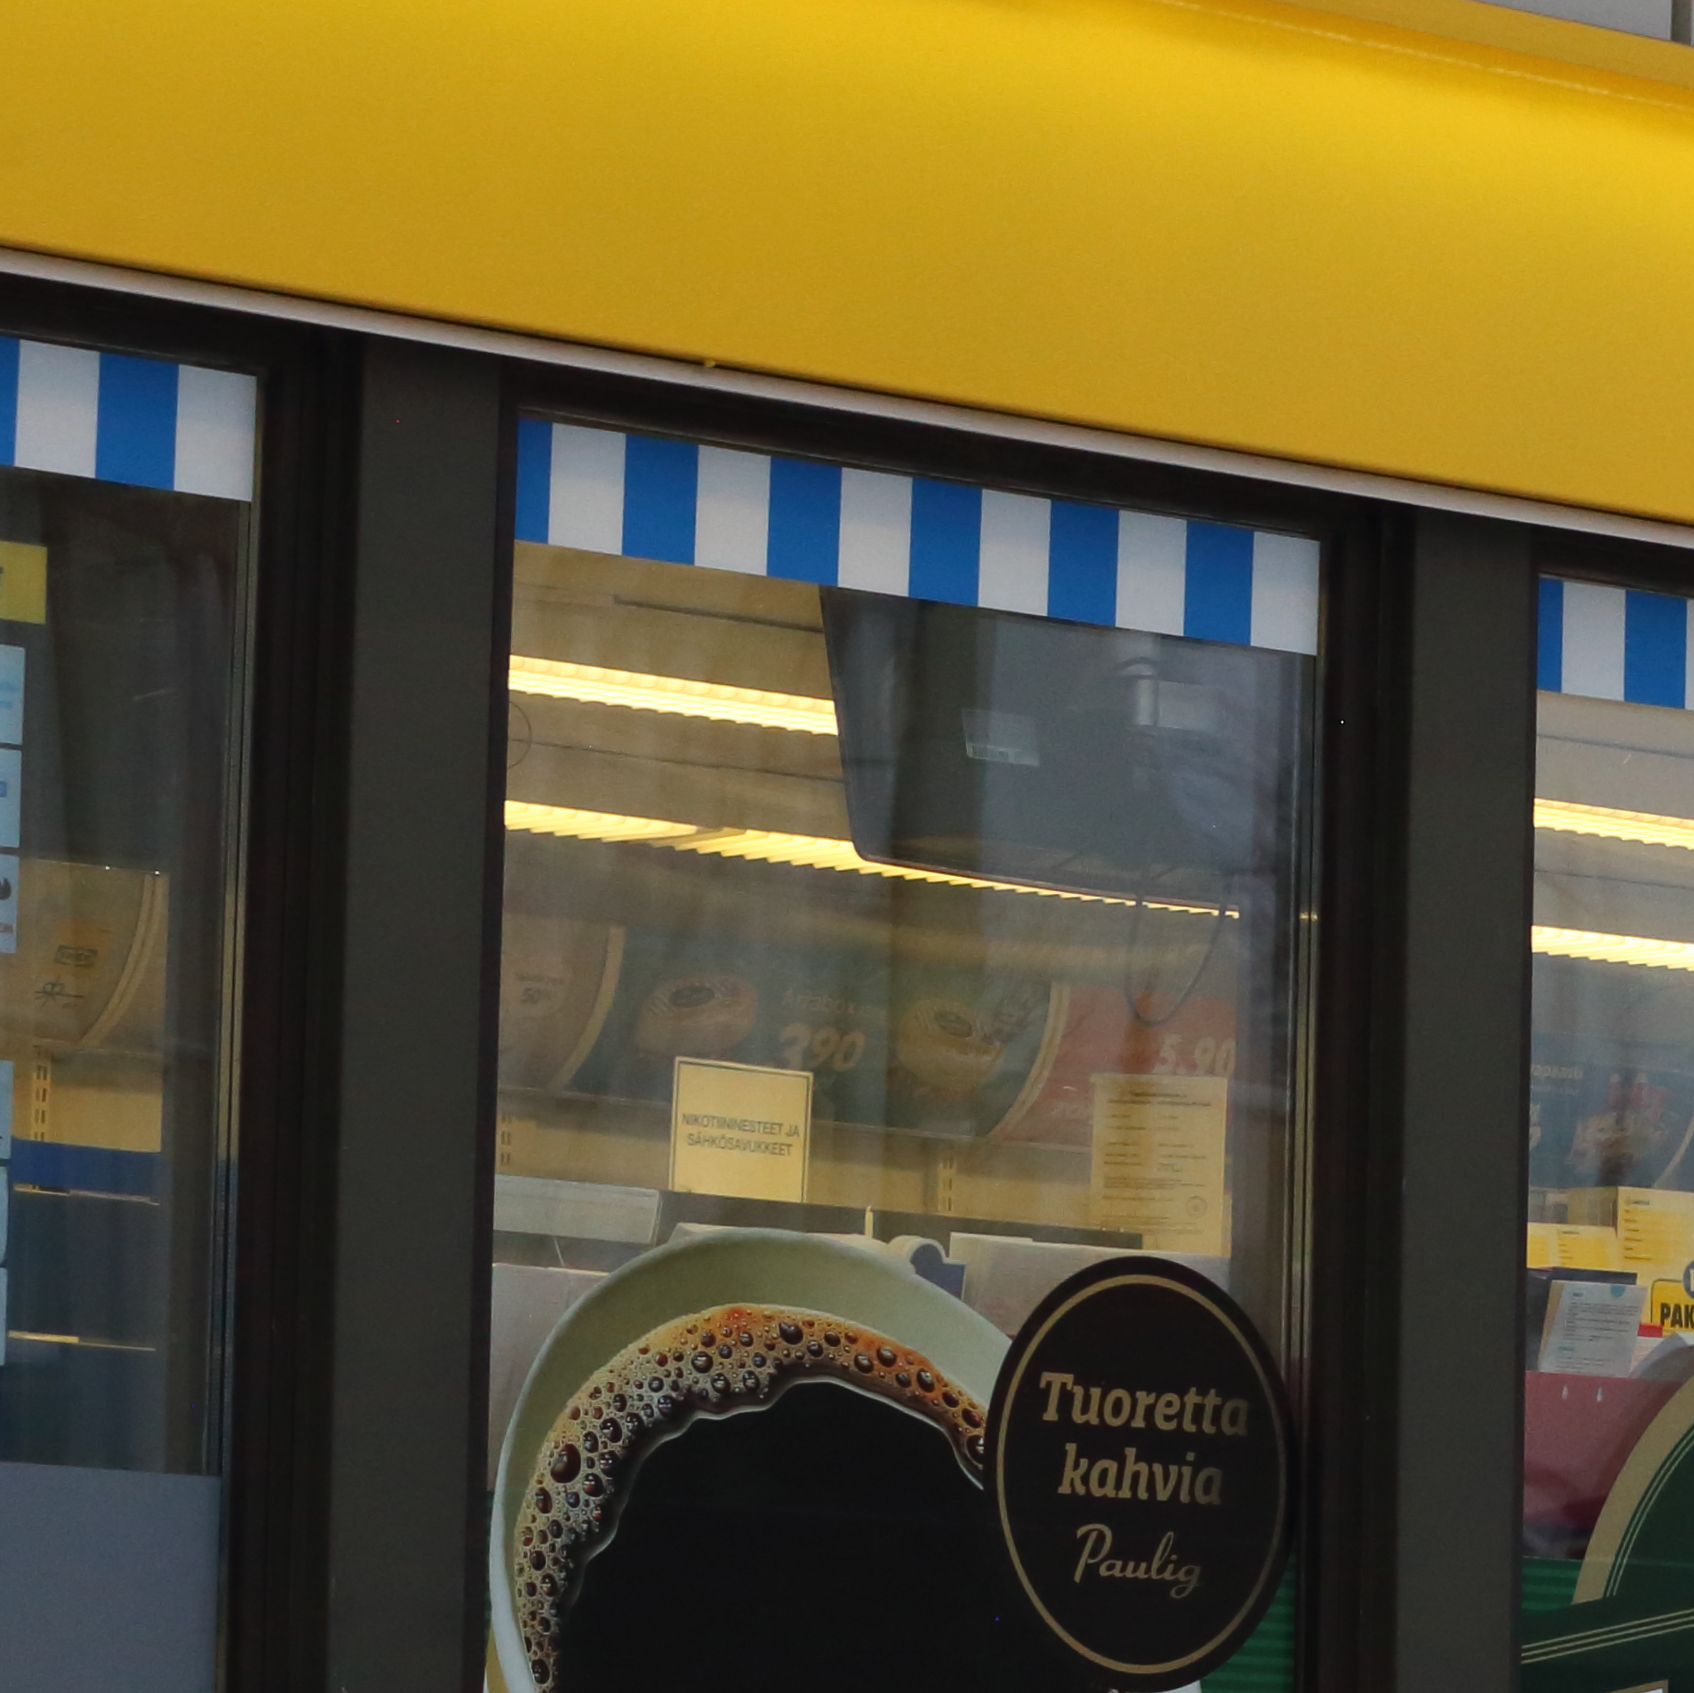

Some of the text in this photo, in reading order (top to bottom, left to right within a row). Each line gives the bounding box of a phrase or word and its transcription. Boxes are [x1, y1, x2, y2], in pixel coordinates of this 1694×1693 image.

[687, 1131, 793, 1157] SÄHKÖSAVUKKEET
[785, 1124, 801, 1138] JA
[1039, 1371, 1249, 1438] Tuoretta
[1057, 1442, 1223, 1506] kahvia
[1073, 1522, 1202, 1600] Paulig
